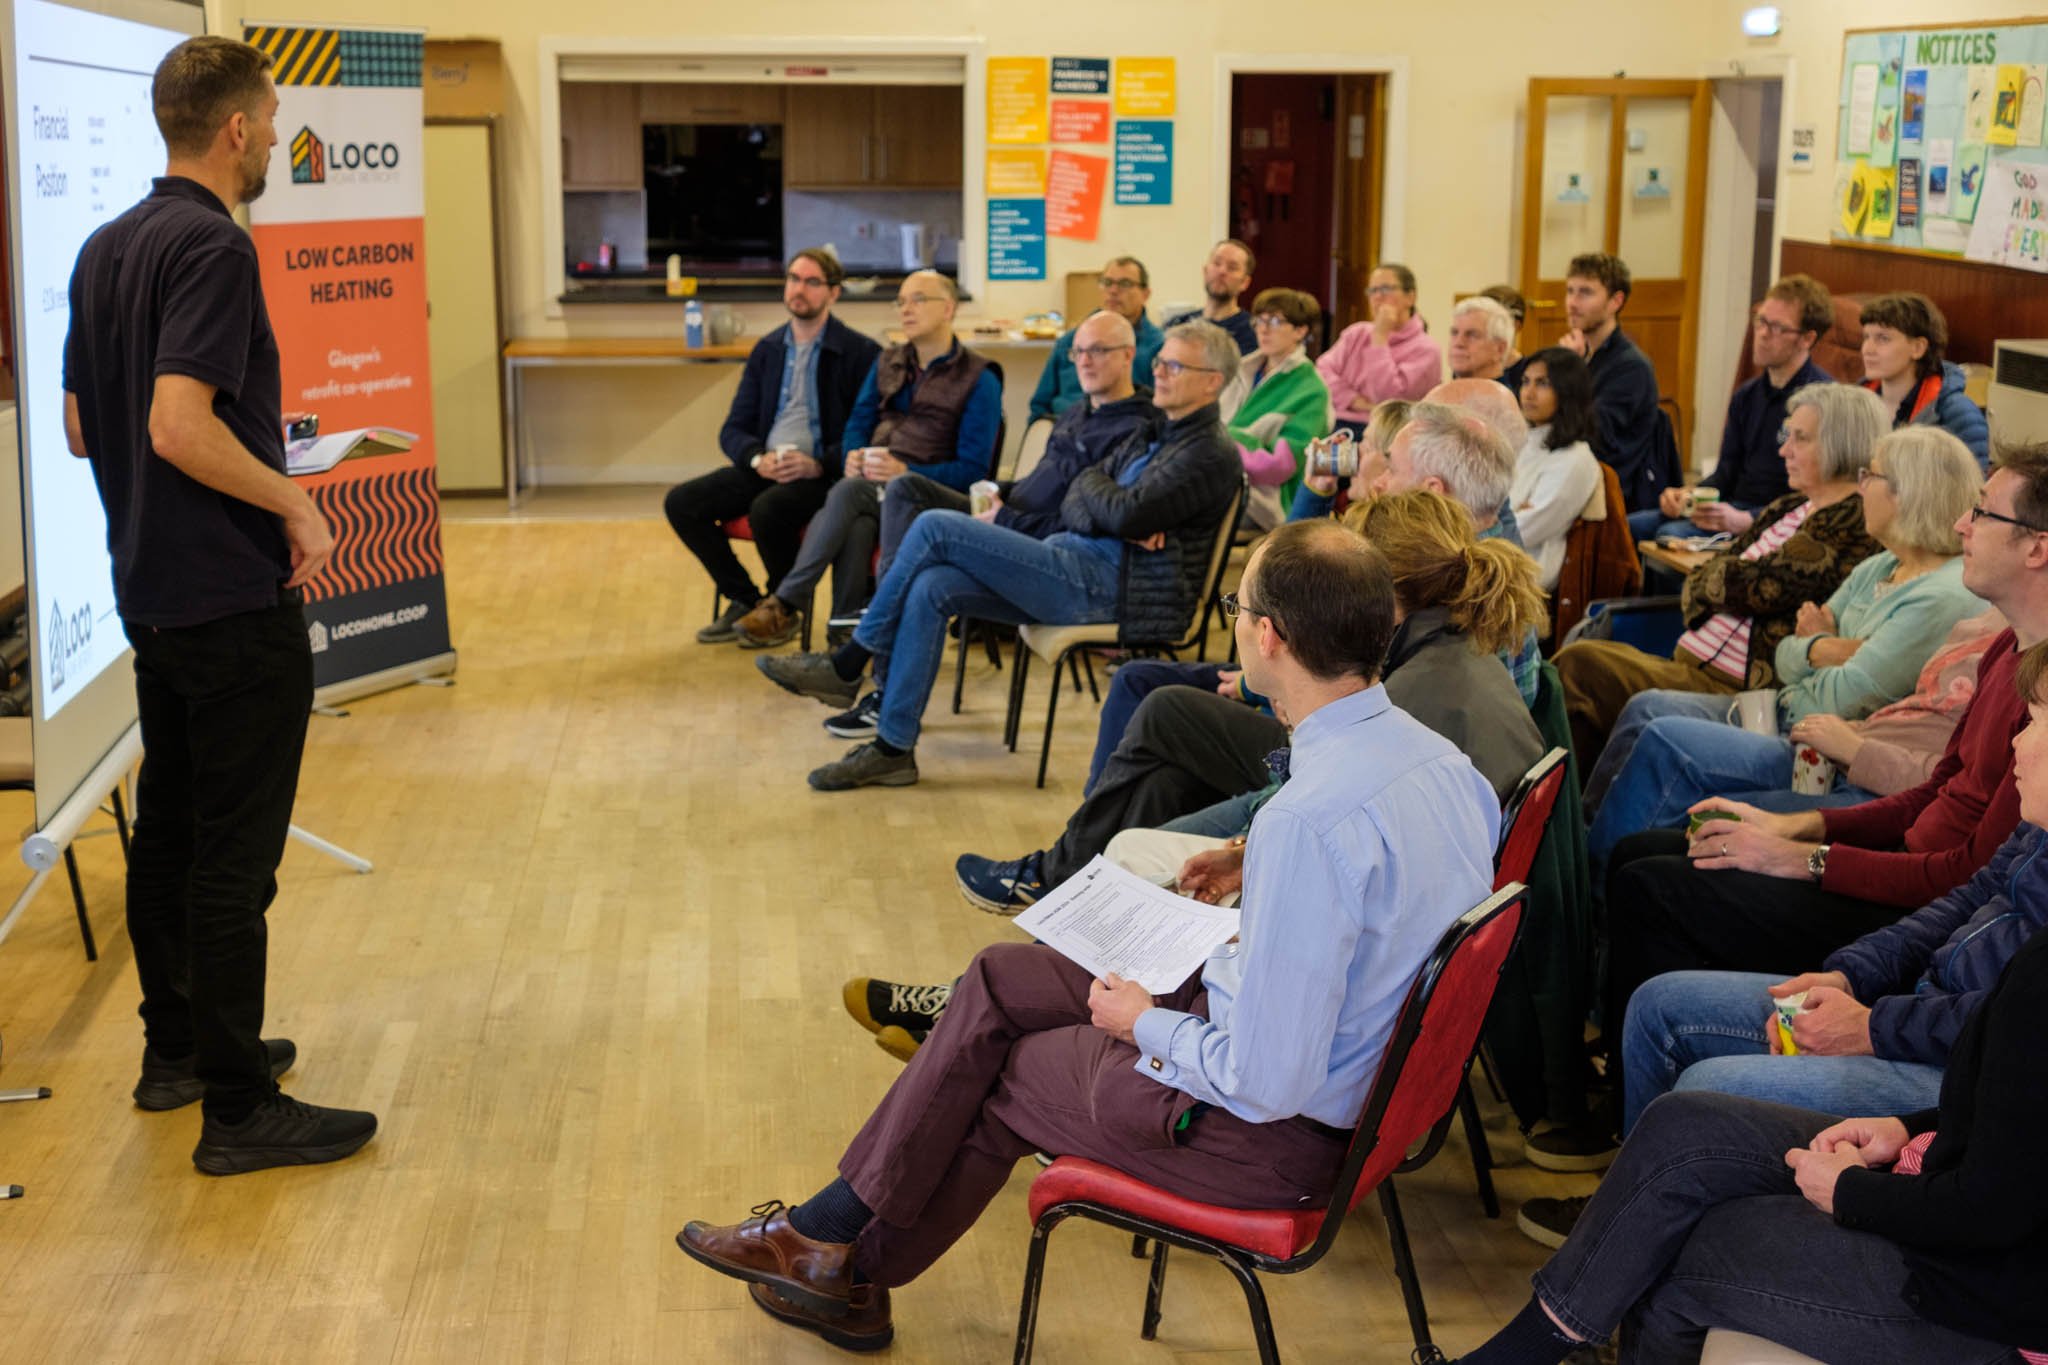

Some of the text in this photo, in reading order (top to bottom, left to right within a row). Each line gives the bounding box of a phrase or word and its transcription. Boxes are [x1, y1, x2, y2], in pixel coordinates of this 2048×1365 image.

[1916, 33, 1996, 65] NOTICES
[33, 104, 69, 141] Financial
[329, 143, 399, 169] LOCO
[36, 163, 68, 199] Position
[2014, 170, 2037, 190] GOD
[2011, 196, 2046, 220] MADE
[286, 243, 414, 270] LOW CARBON
[310, 277, 393, 304] HEATING
[302, 373, 412, 400] retrofit co-operative
[65, 602, 92, 658] LOCO
[331, 604, 428, 640] LOCOHOME.COOP
